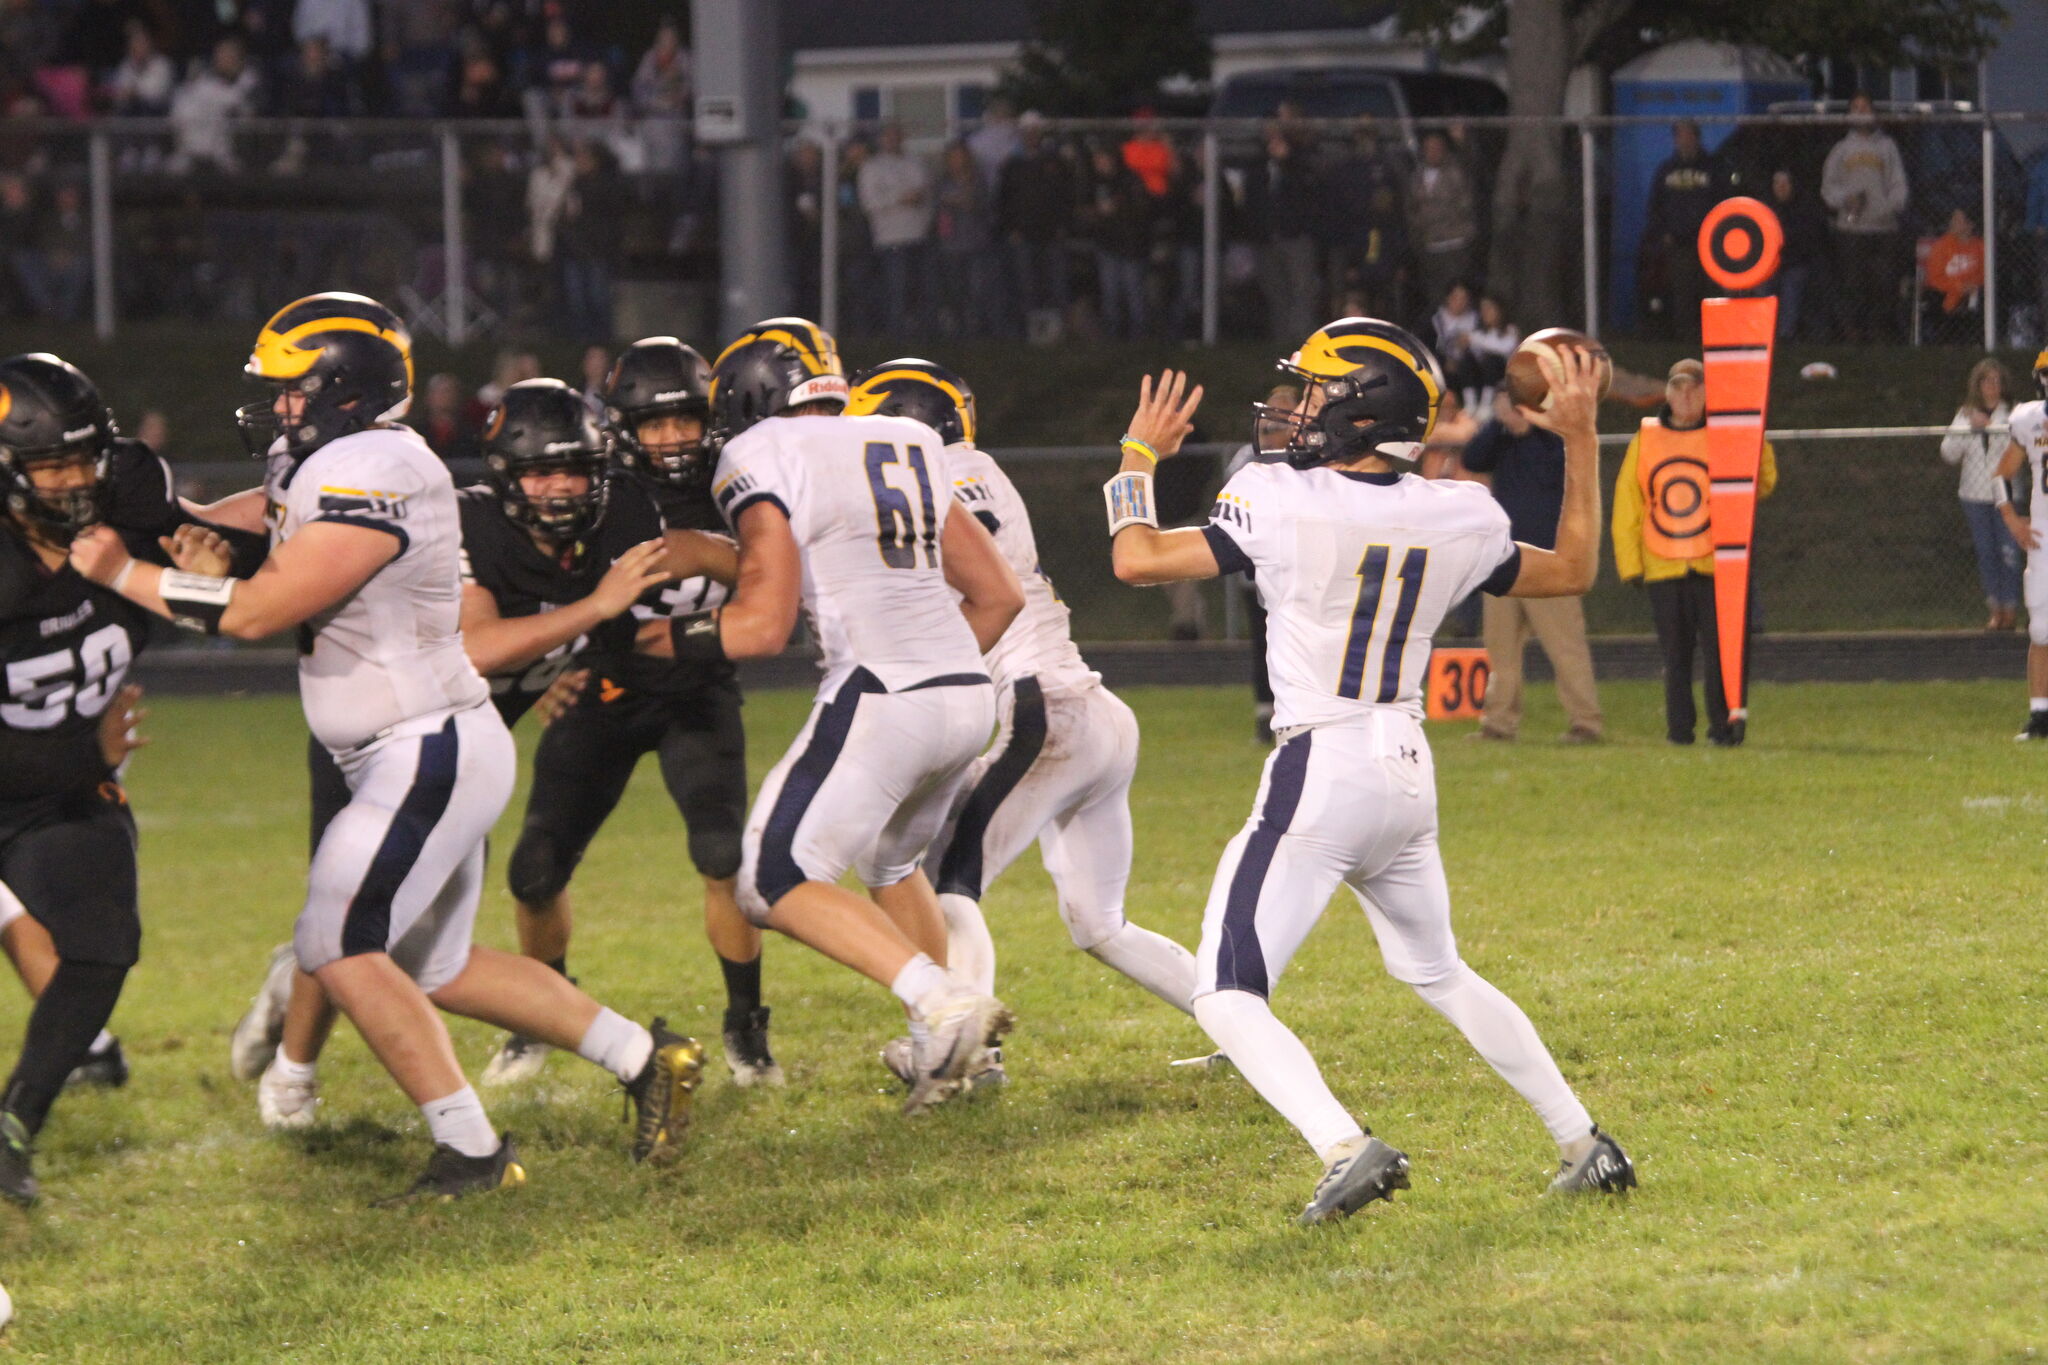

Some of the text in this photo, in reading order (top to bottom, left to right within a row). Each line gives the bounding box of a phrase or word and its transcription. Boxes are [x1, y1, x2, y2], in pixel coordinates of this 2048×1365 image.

[864, 440, 938, 569] 61
[1336, 543, 1430, 704] 11
[1442, 658, 1489, 711] 30
